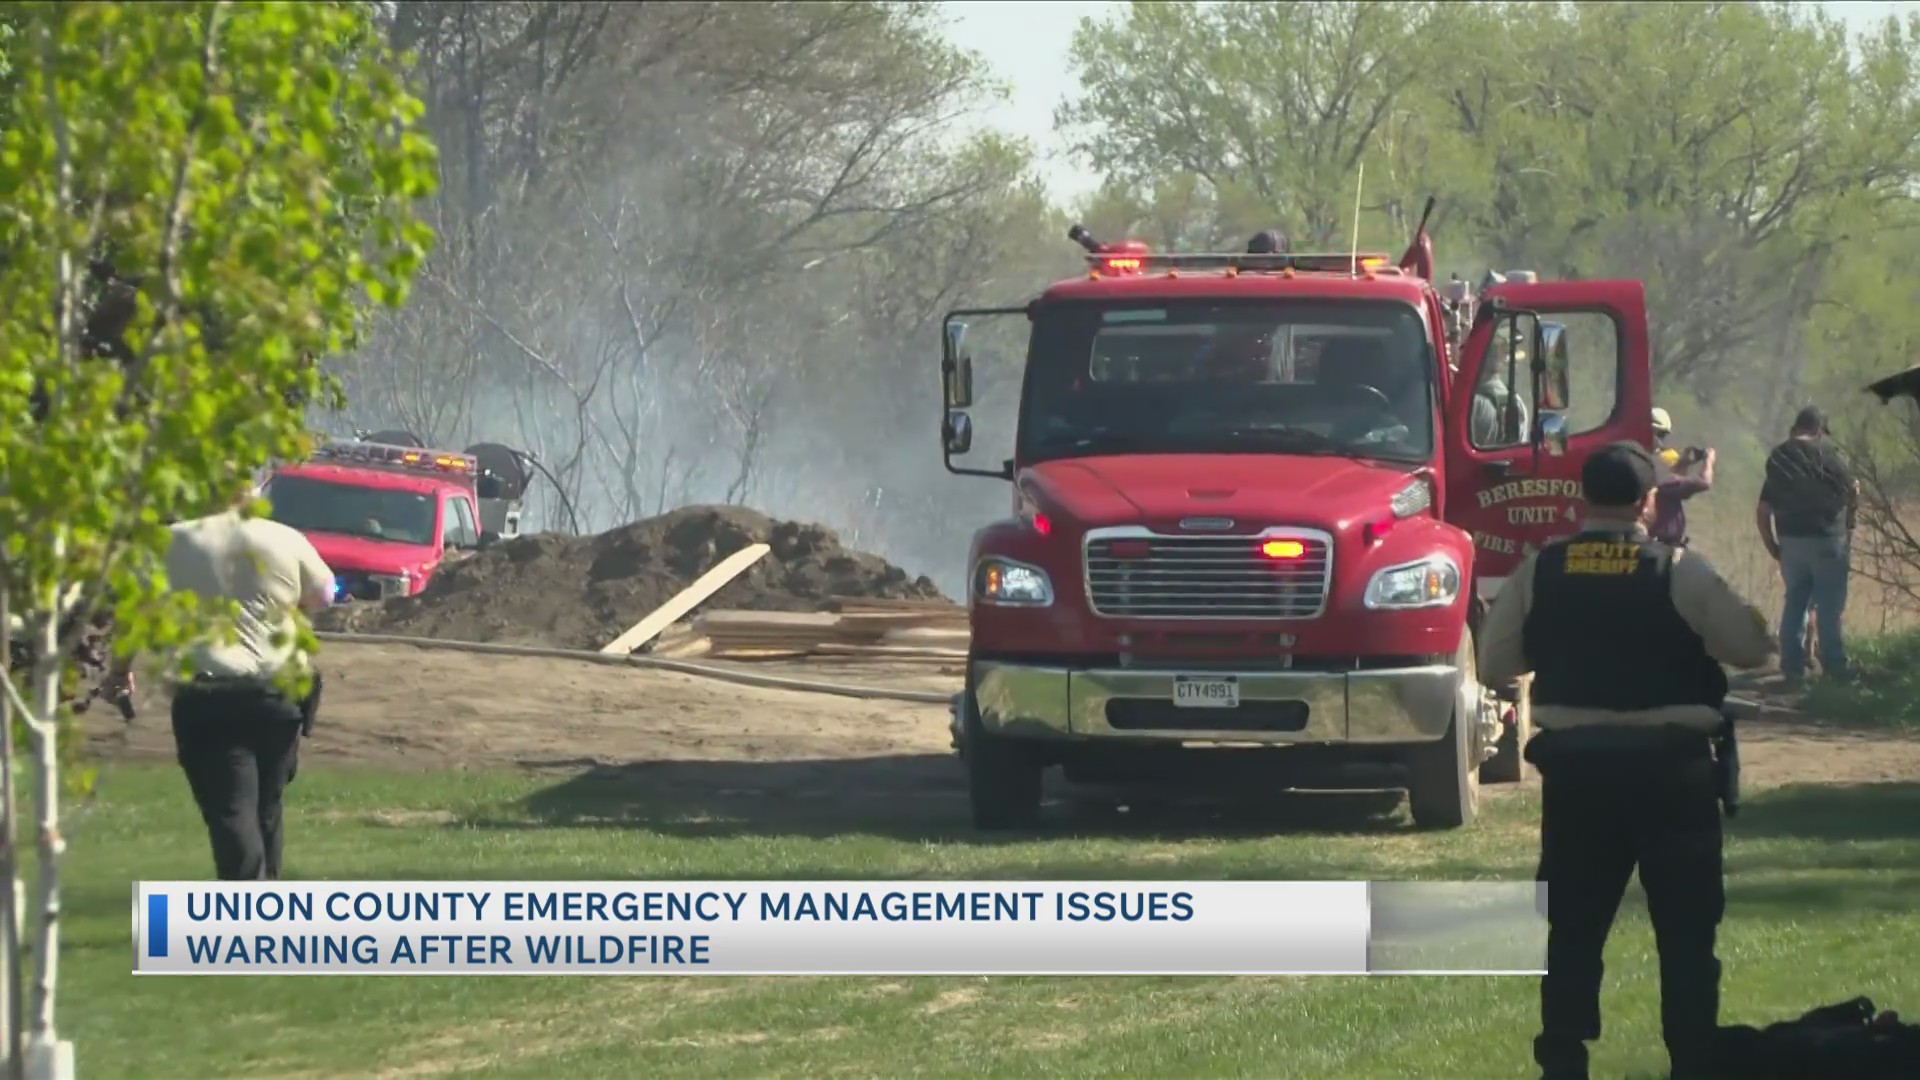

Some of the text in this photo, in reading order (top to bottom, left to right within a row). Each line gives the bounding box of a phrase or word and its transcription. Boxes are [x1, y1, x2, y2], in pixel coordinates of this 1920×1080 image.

[1507, 506, 1576, 524] UNIT 4
[1474, 531, 1515, 554] FIRE
[1566, 543, 1640, 559] DEPUTY
[1564, 559, 1639, 574] SHERIFF
[1177, 682, 1234, 699] CTY4991
